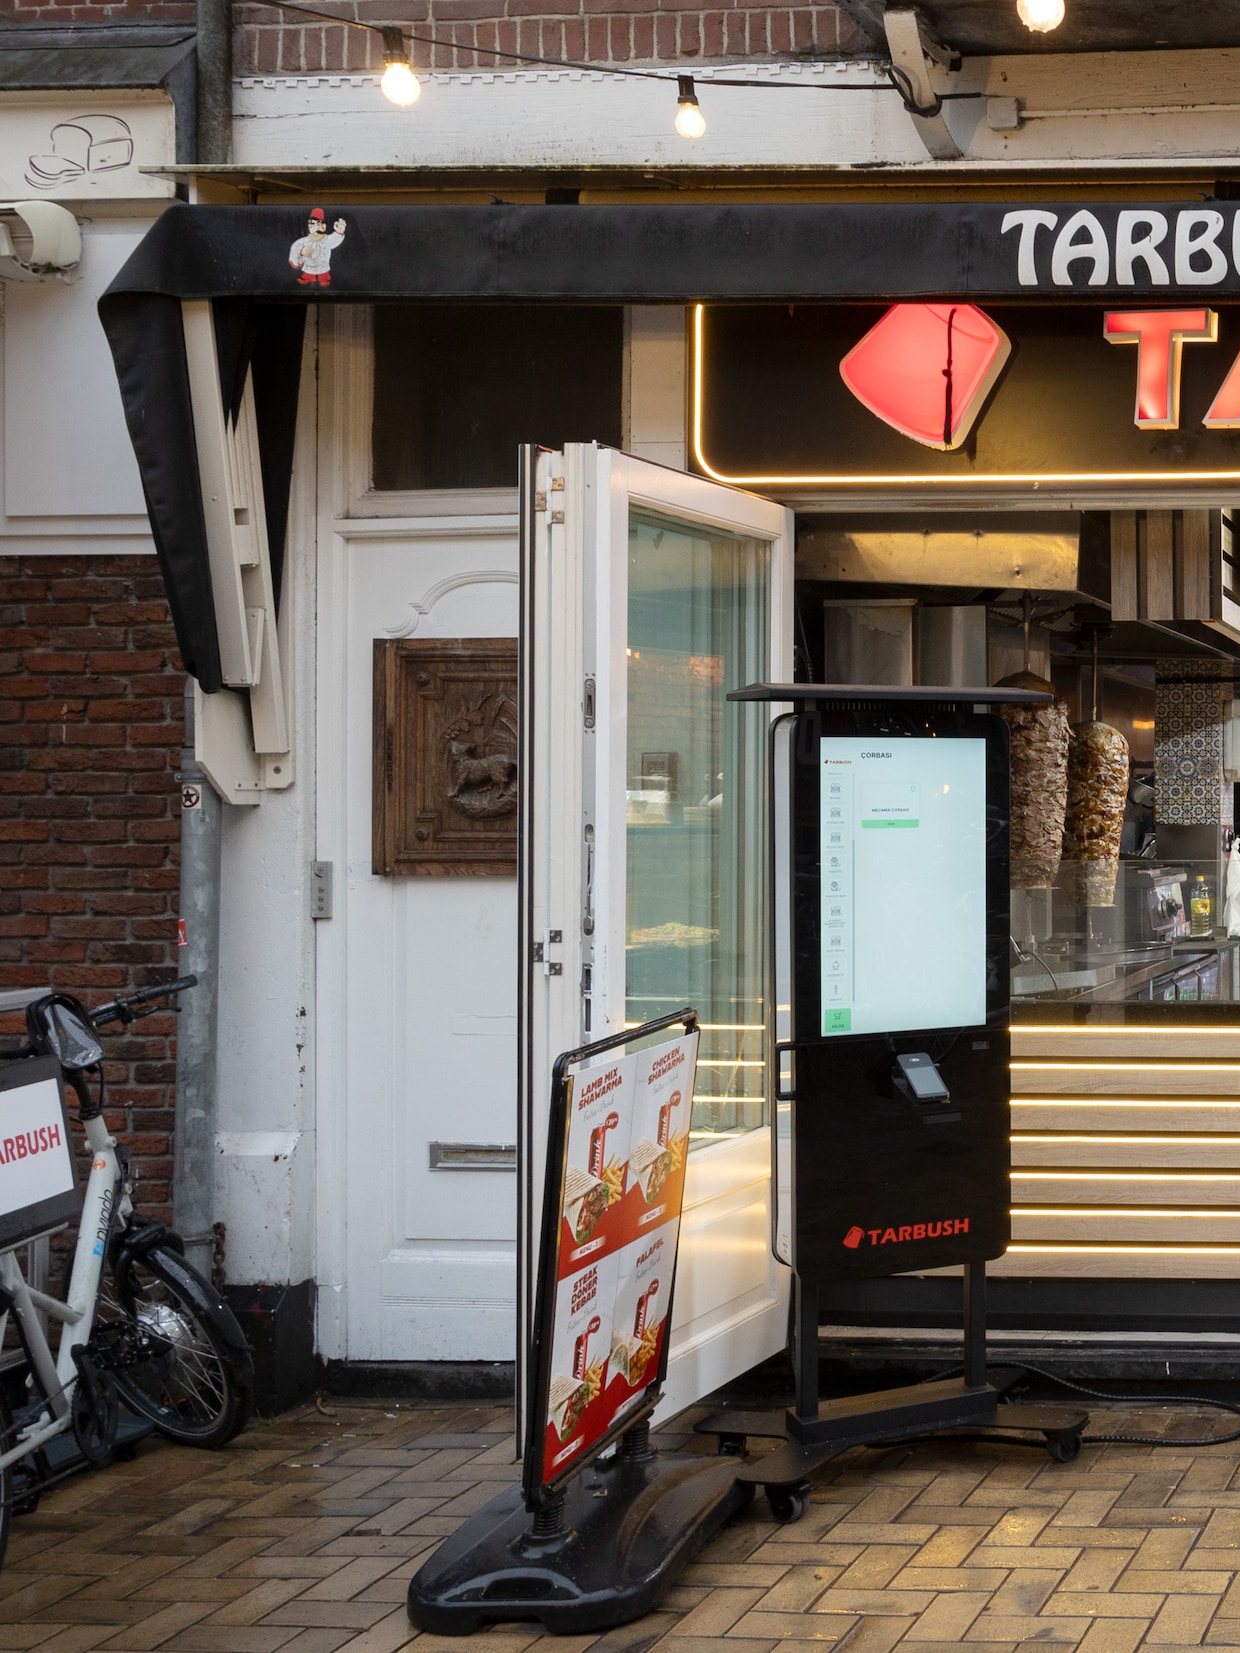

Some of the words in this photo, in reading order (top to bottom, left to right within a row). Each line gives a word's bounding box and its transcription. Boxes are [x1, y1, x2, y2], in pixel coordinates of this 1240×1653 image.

[860, 752, 892, 760] ÇORBASI
[648, 1053, 685, 1085] SHAWARMA
[652, 1046, 680, 1071] CHICKEN
[578, 1075, 622, 1111] SHAWARMA
[581, 1076, 603, 1098] LAMB
[604, 1066, 618, 1083] MIX
[592, 1139, 601, 1177] Drink
[868, 1218, 970, 1246] TARBUSH
[636, 1237, 664, 1267] FALAFEL
[573, 1265, 598, 1292] STEAK
[571, 1287, 597, 1316] KEBAB
[575, 1344, 585, 1380] Drink
